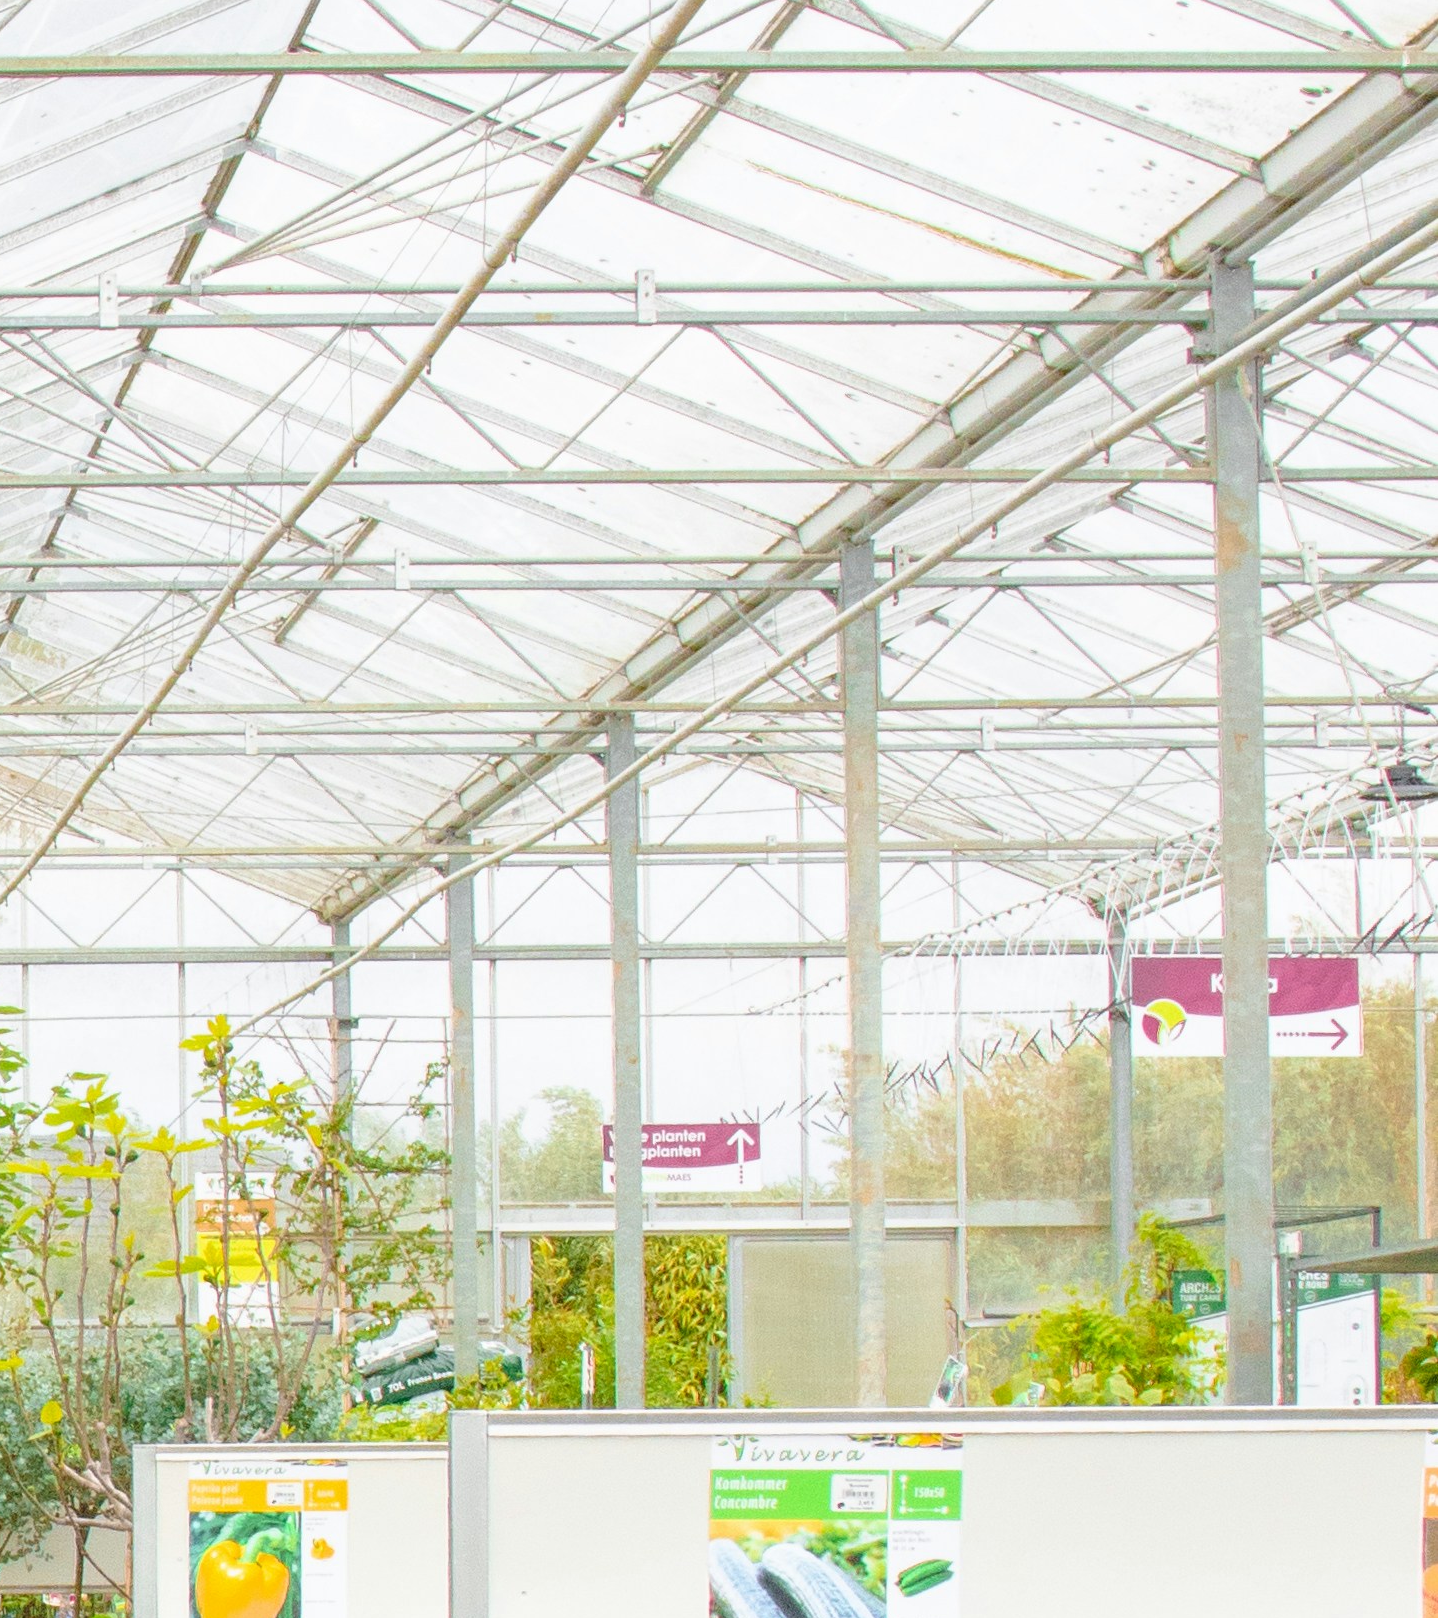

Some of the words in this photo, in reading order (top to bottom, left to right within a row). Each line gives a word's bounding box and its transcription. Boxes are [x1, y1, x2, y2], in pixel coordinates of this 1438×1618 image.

[652, 1129, 706, 1145] planten
[730, 1435, 865, 1462] Vivavera
[714, 1476, 788, 1491] Komkommer
[914, 1487, 945, 1498] 150x50
[714, 1495, 779, 1510] Concombre
